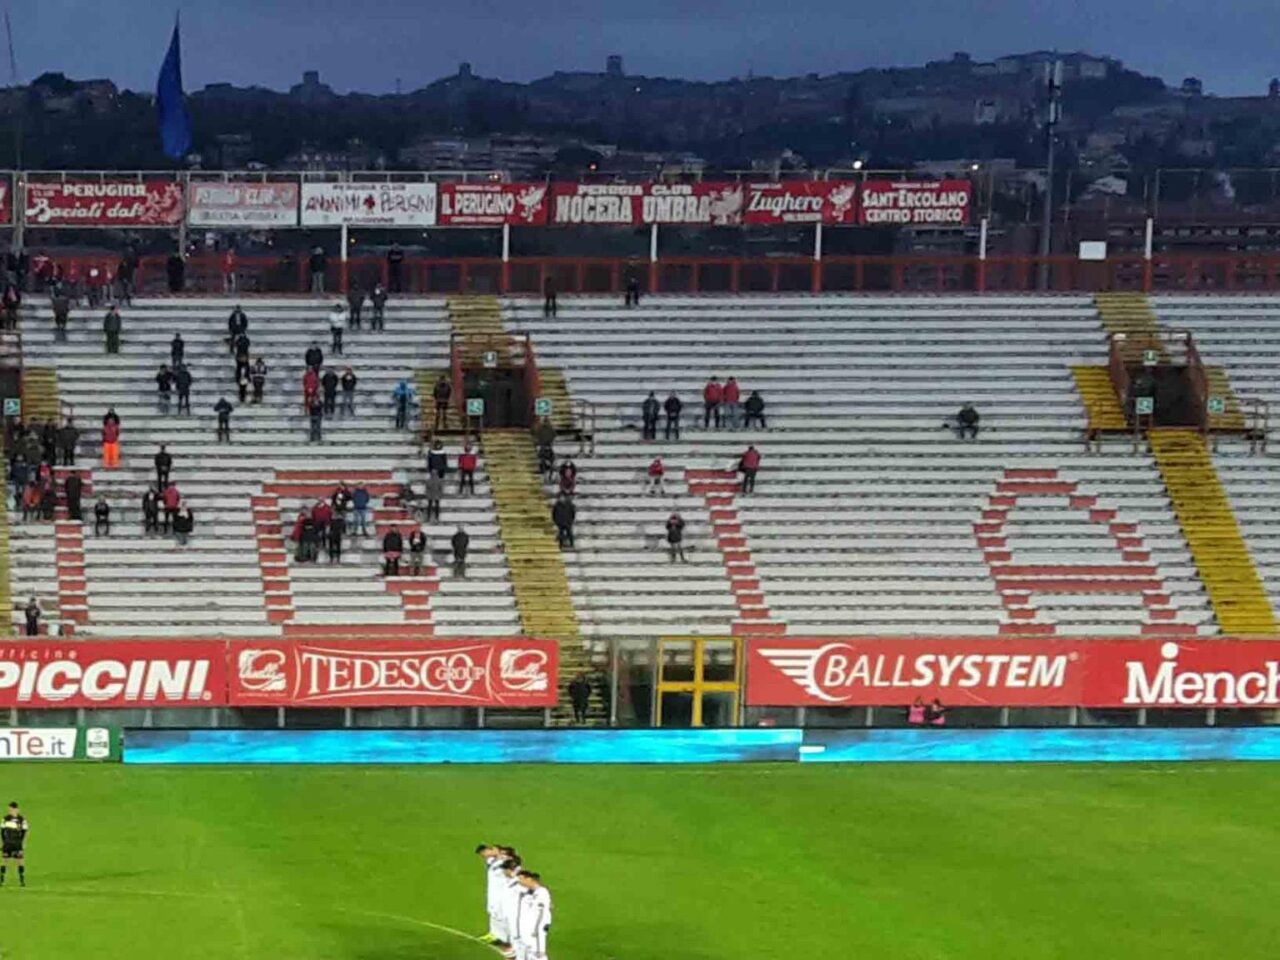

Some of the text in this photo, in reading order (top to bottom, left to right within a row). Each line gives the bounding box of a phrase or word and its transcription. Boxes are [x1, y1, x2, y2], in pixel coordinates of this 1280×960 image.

[63, 184, 146, 197] PERUGINA
[577, 185, 693, 195] PERUGIA CLUB
[455, 194, 514, 214] PERUGINO
[556, 195, 710, 222] NOCERA UMBRA
[749, 191, 823, 216] Zughero
[866, 209, 962, 222] CENTRO STORICO
[302, 653, 473, 693] TEDESCO
[823, 655, 1067, 687] BALLSYSTEM
